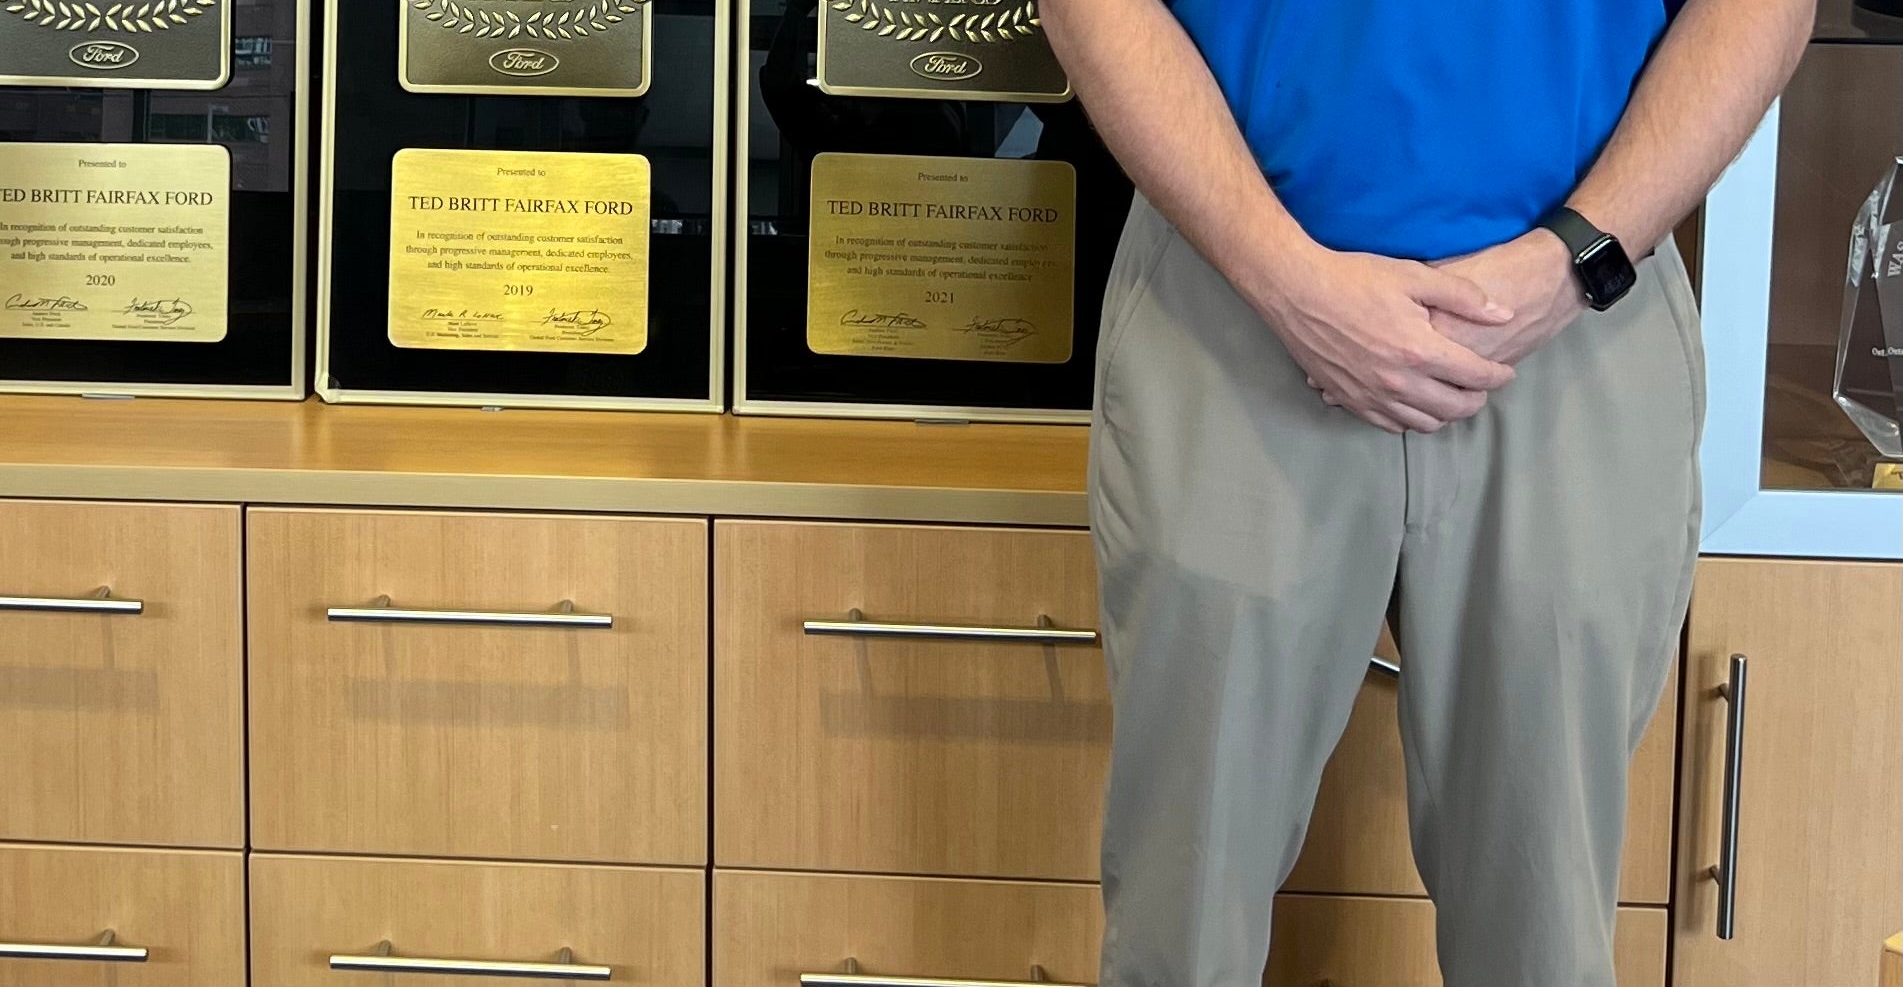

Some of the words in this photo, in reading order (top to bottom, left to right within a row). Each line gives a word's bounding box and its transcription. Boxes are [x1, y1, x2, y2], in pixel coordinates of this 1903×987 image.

[83, 45, 124, 62] Ford
[504, 52, 543, 70] Ford
[924, 55, 967, 74] Ford
[497, 168, 535, 176] Presented
[538, 169, 545, 177] to
[31, 190, 82, 203] BRITT
[87, 190, 159, 205] FAIRFAX
[166, 192, 213, 205] FORD
[408, 196, 443, 210] TED
[449, 197, 500, 211] BRITT
[505, 199, 579, 214] FAIRFAX
[585, 201, 633, 215] FORD
[827, 201, 863, 215] TED
[868, 202, 921, 218] BRITT
[926, 204, 1002, 221] FAIRFAX
[1008, 208, 1057, 223] FORD
[417, 231, 425, 239] In
[427, 231, 473, 241] recognition
[476, 231, 485, 241] of
[487, 232, 535, 244] outstanding
[537, 235, 574, 243] customer
[577, 235, 623, 244] satisfaction
[406, 245, 437, 255] through
[440, 246, 487, 257] progressive
[489, 248, 543, 258] management,
[546, 248, 584, 258] dedicated
[587, 250, 632, 260] employees,
[428, 261, 442, 269] and
[445, 260, 463, 271] high
[465, 262, 504, 270] standards
[506, 262, 515, 271] of
[517, 263, 562, 273] operational
[86, 275, 115, 286] 2020
[504, 285, 533, 296] 2019
[925, 292, 955, 304] 2021
